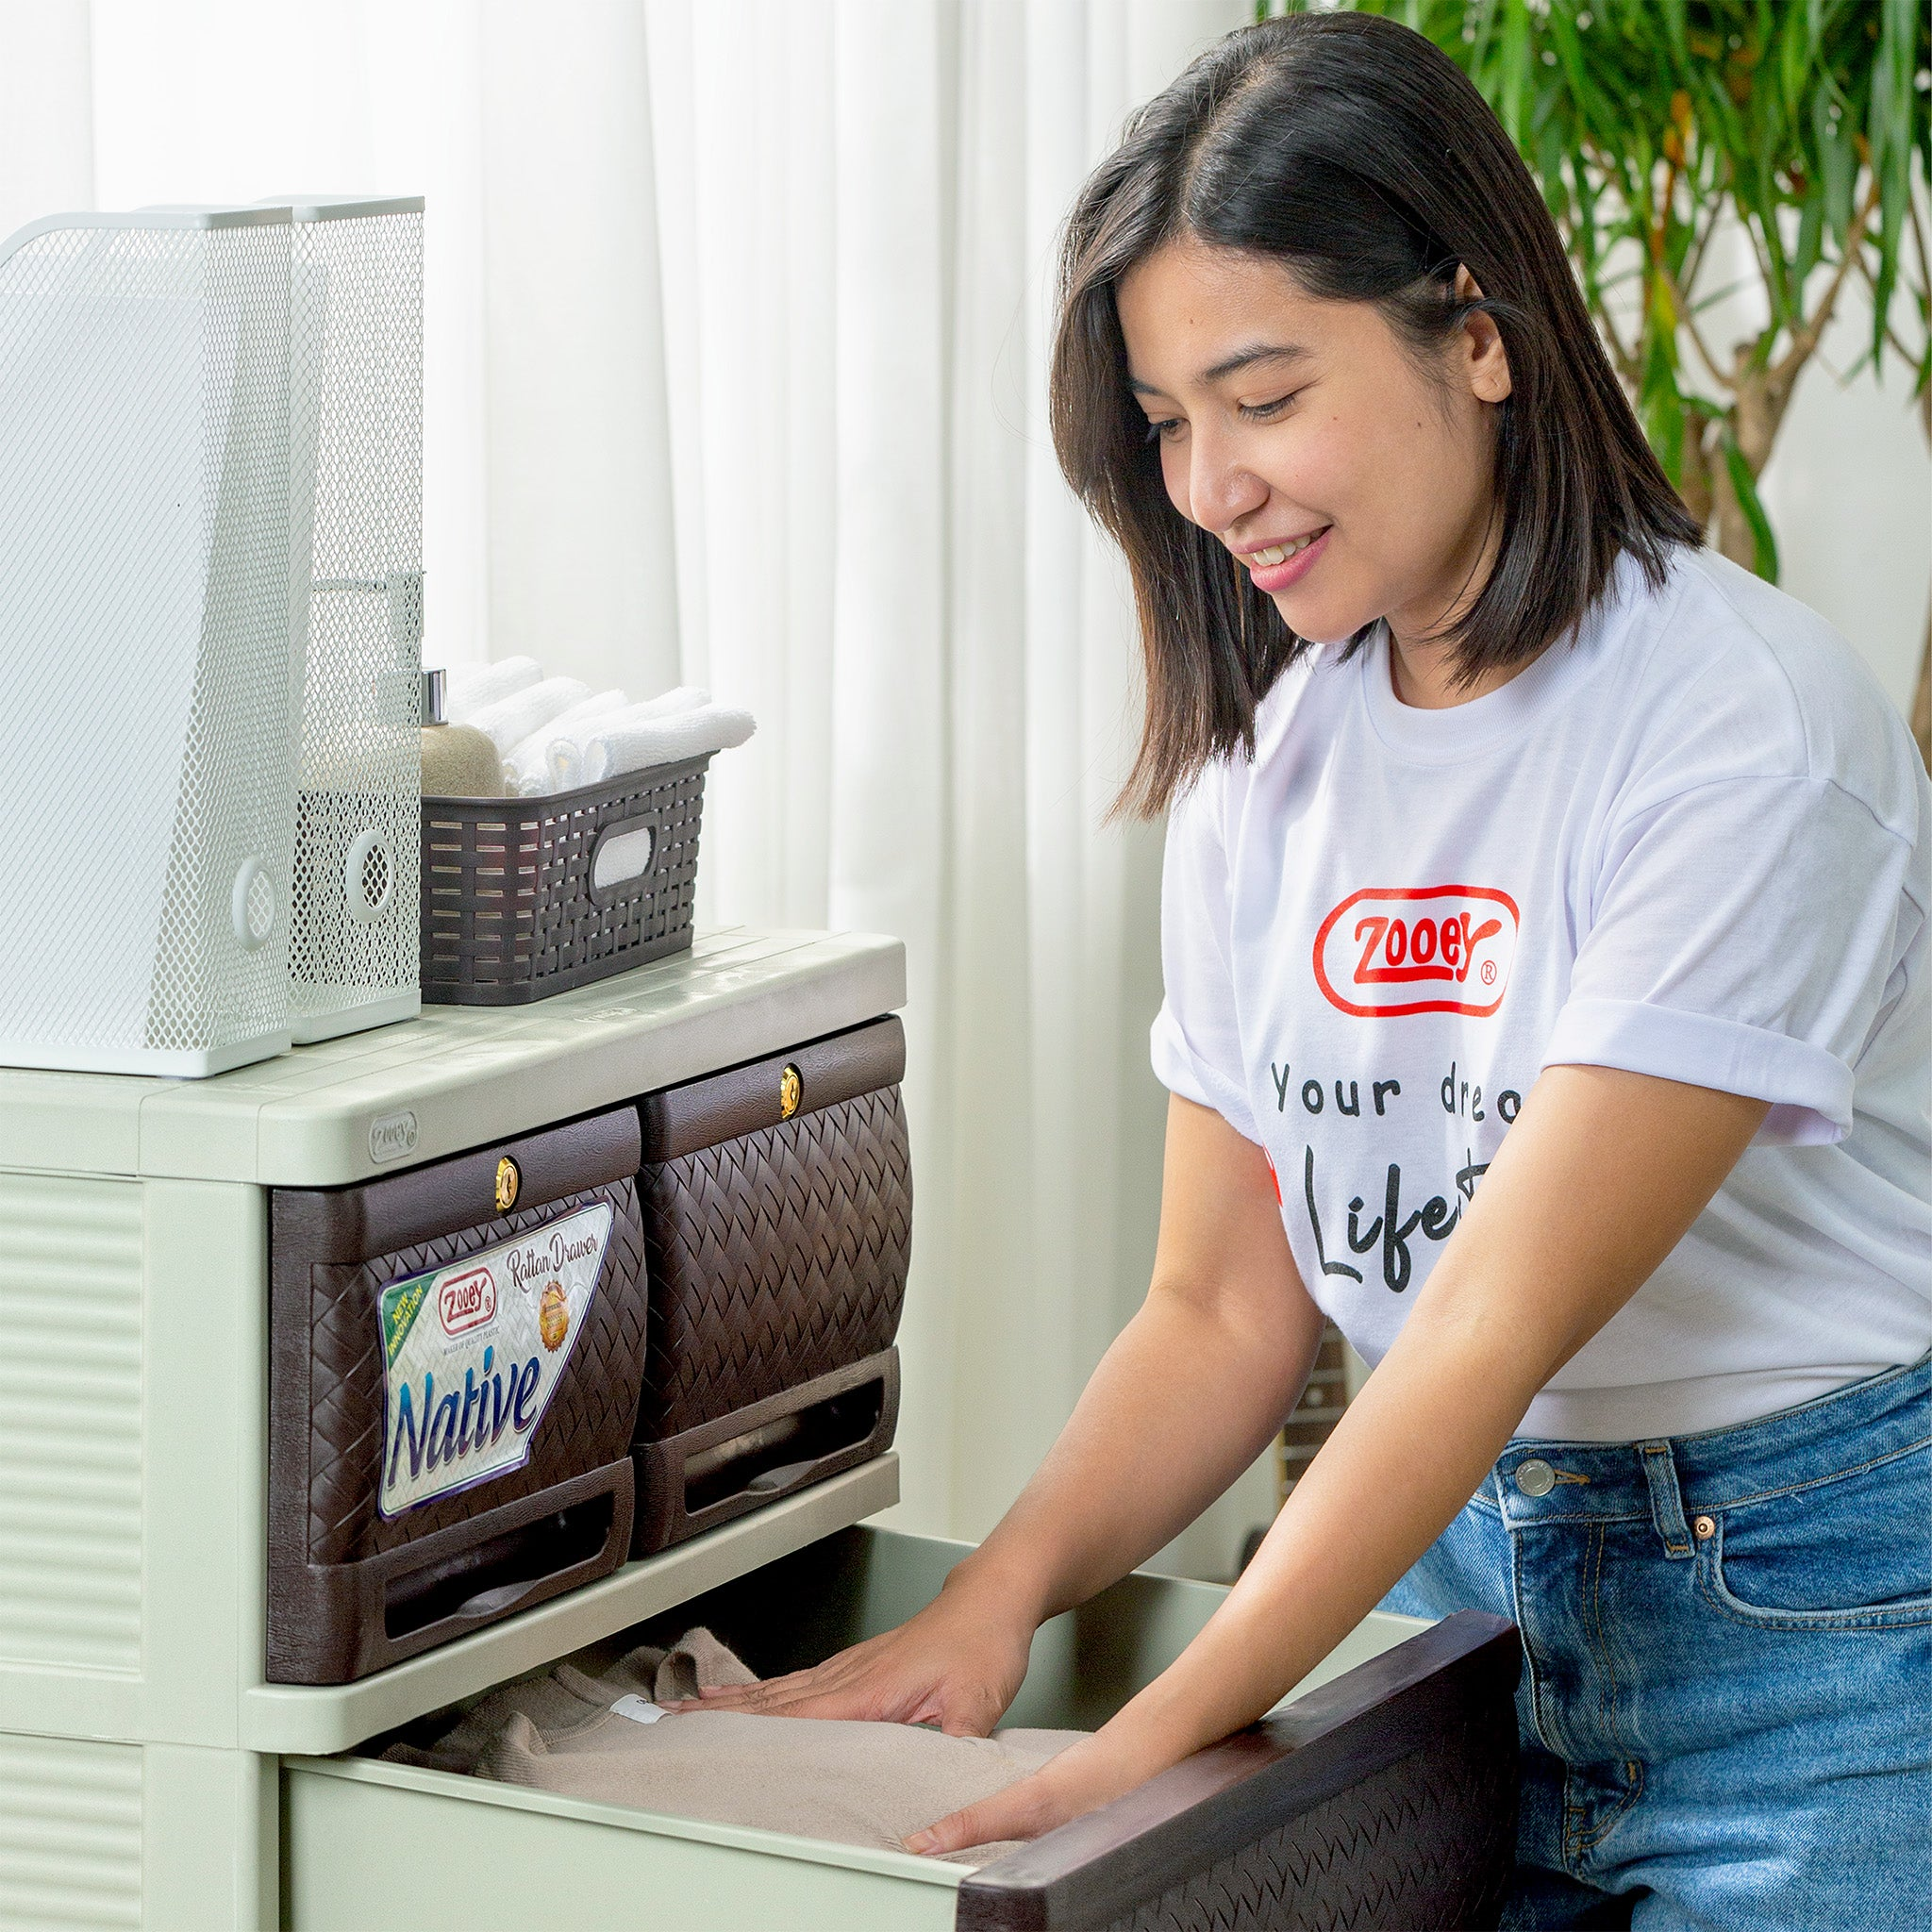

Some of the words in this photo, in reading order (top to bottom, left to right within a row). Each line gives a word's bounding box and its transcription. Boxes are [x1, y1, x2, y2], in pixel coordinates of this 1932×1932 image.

[1271, 1061, 1401, 1117] Your
[507, 1248, 550, 1293] Rattan
[549, 1232, 598, 1273] Drawer
[388, 1283, 423, 1357] INNOVATION
[391, 1291, 409, 1324] NEW
[388, 1344, 541, 1489] Native
